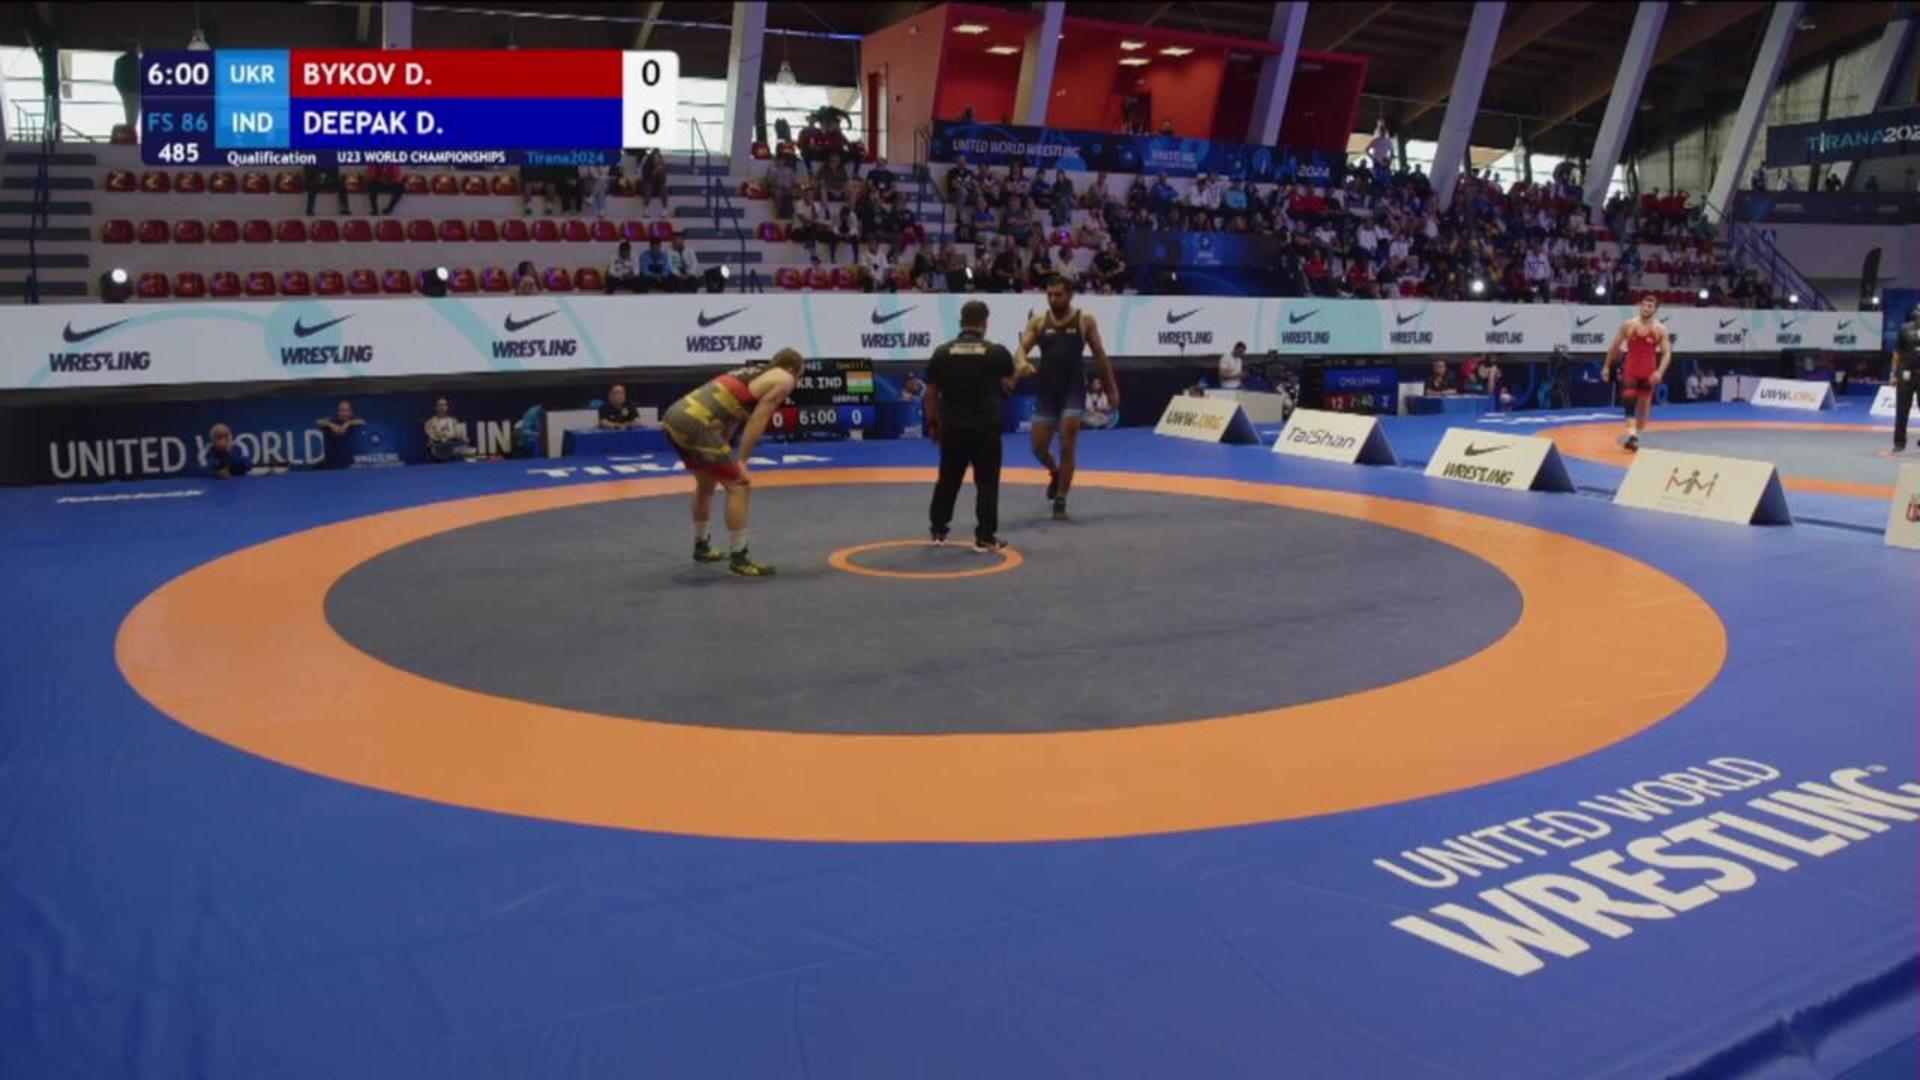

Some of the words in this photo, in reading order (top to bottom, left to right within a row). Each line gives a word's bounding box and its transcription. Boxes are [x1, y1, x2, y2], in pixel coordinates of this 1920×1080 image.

[952, 139, 988, 153] UNITED
[990, 142, 1024, 154] WORLD
[686, 334, 762, 353] WRESTLING
[861, 331, 931, 349] WRESTLING
[1158, 331, 1213, 344] WRESTLING
[1281, 331, 1330, 344] WRESTLING
[281, 345, 373, 365] WRESTLING
[492, 339, 577, 359] WRESTLING
[49, 352, 151, 372] WRESTLING
[796, 376, 814, 389] KR
[819, 376, 842, 389] IND
[772, 411, 783, 428] 0
[799, 409, 837, 425] 6:00
[851, 409, 862, 425] 0
[1286, 426, 1356, 448] TaiShan
[50, 436, 187, 479] UNITED
[1443, 463, 1515, 486] WRESTLING
[1373, 809, 1612, 888] UNITED
[1578, 757, 1781, 822] WORLD
[1390, 767, 1920, 976] WRESTLING
